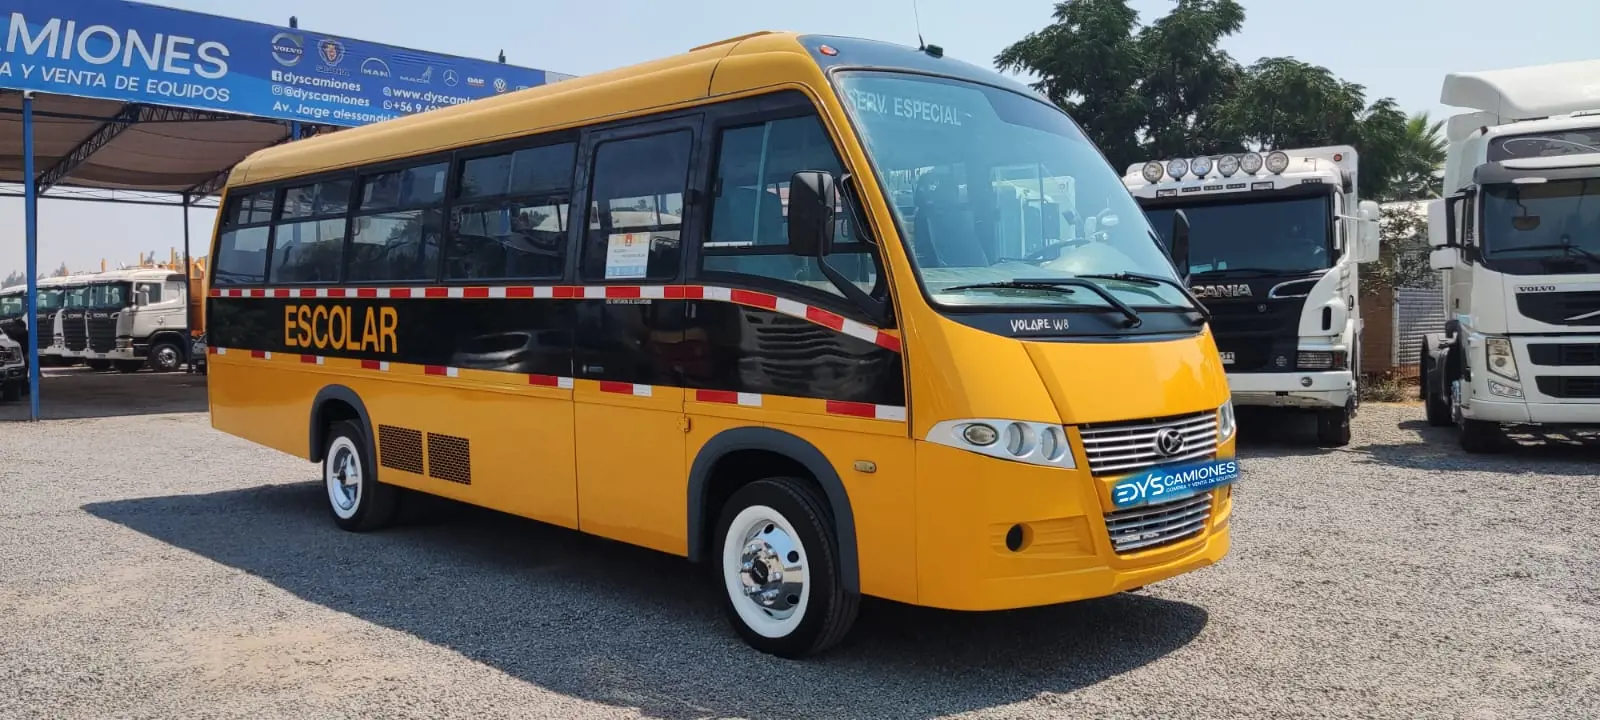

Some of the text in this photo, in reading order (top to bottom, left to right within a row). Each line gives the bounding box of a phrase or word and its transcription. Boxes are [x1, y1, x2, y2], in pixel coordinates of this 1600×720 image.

[0, 12, 230, 79] MIONES
[273, 45, 303, 55] VOLVO
[284, 72, 361, 92] dyscamiones
[363, 68, 388, 78] MAN
[21, 63, 35, 79] Y
[41, 66, 107, 88] VENTA
[115, 75, 140, 92] DE
[146, 79, 230, 102] EQUIPOS
[284, 88, 370, 107] @dyscamiones
[273, 101, 292, 113] Av.
[296, 103, 330, 118] Jorge
[393, 101, 412, 112] +56
[415, 103, 422, 113] 9
[894, 98, 962, 126] ESPECIAL
[1188, 284, 1253, 298] CANIA
[285, 304, 398, 353] ESCOLAR
[1010, 318, 1069, 332] VOLARE W8
